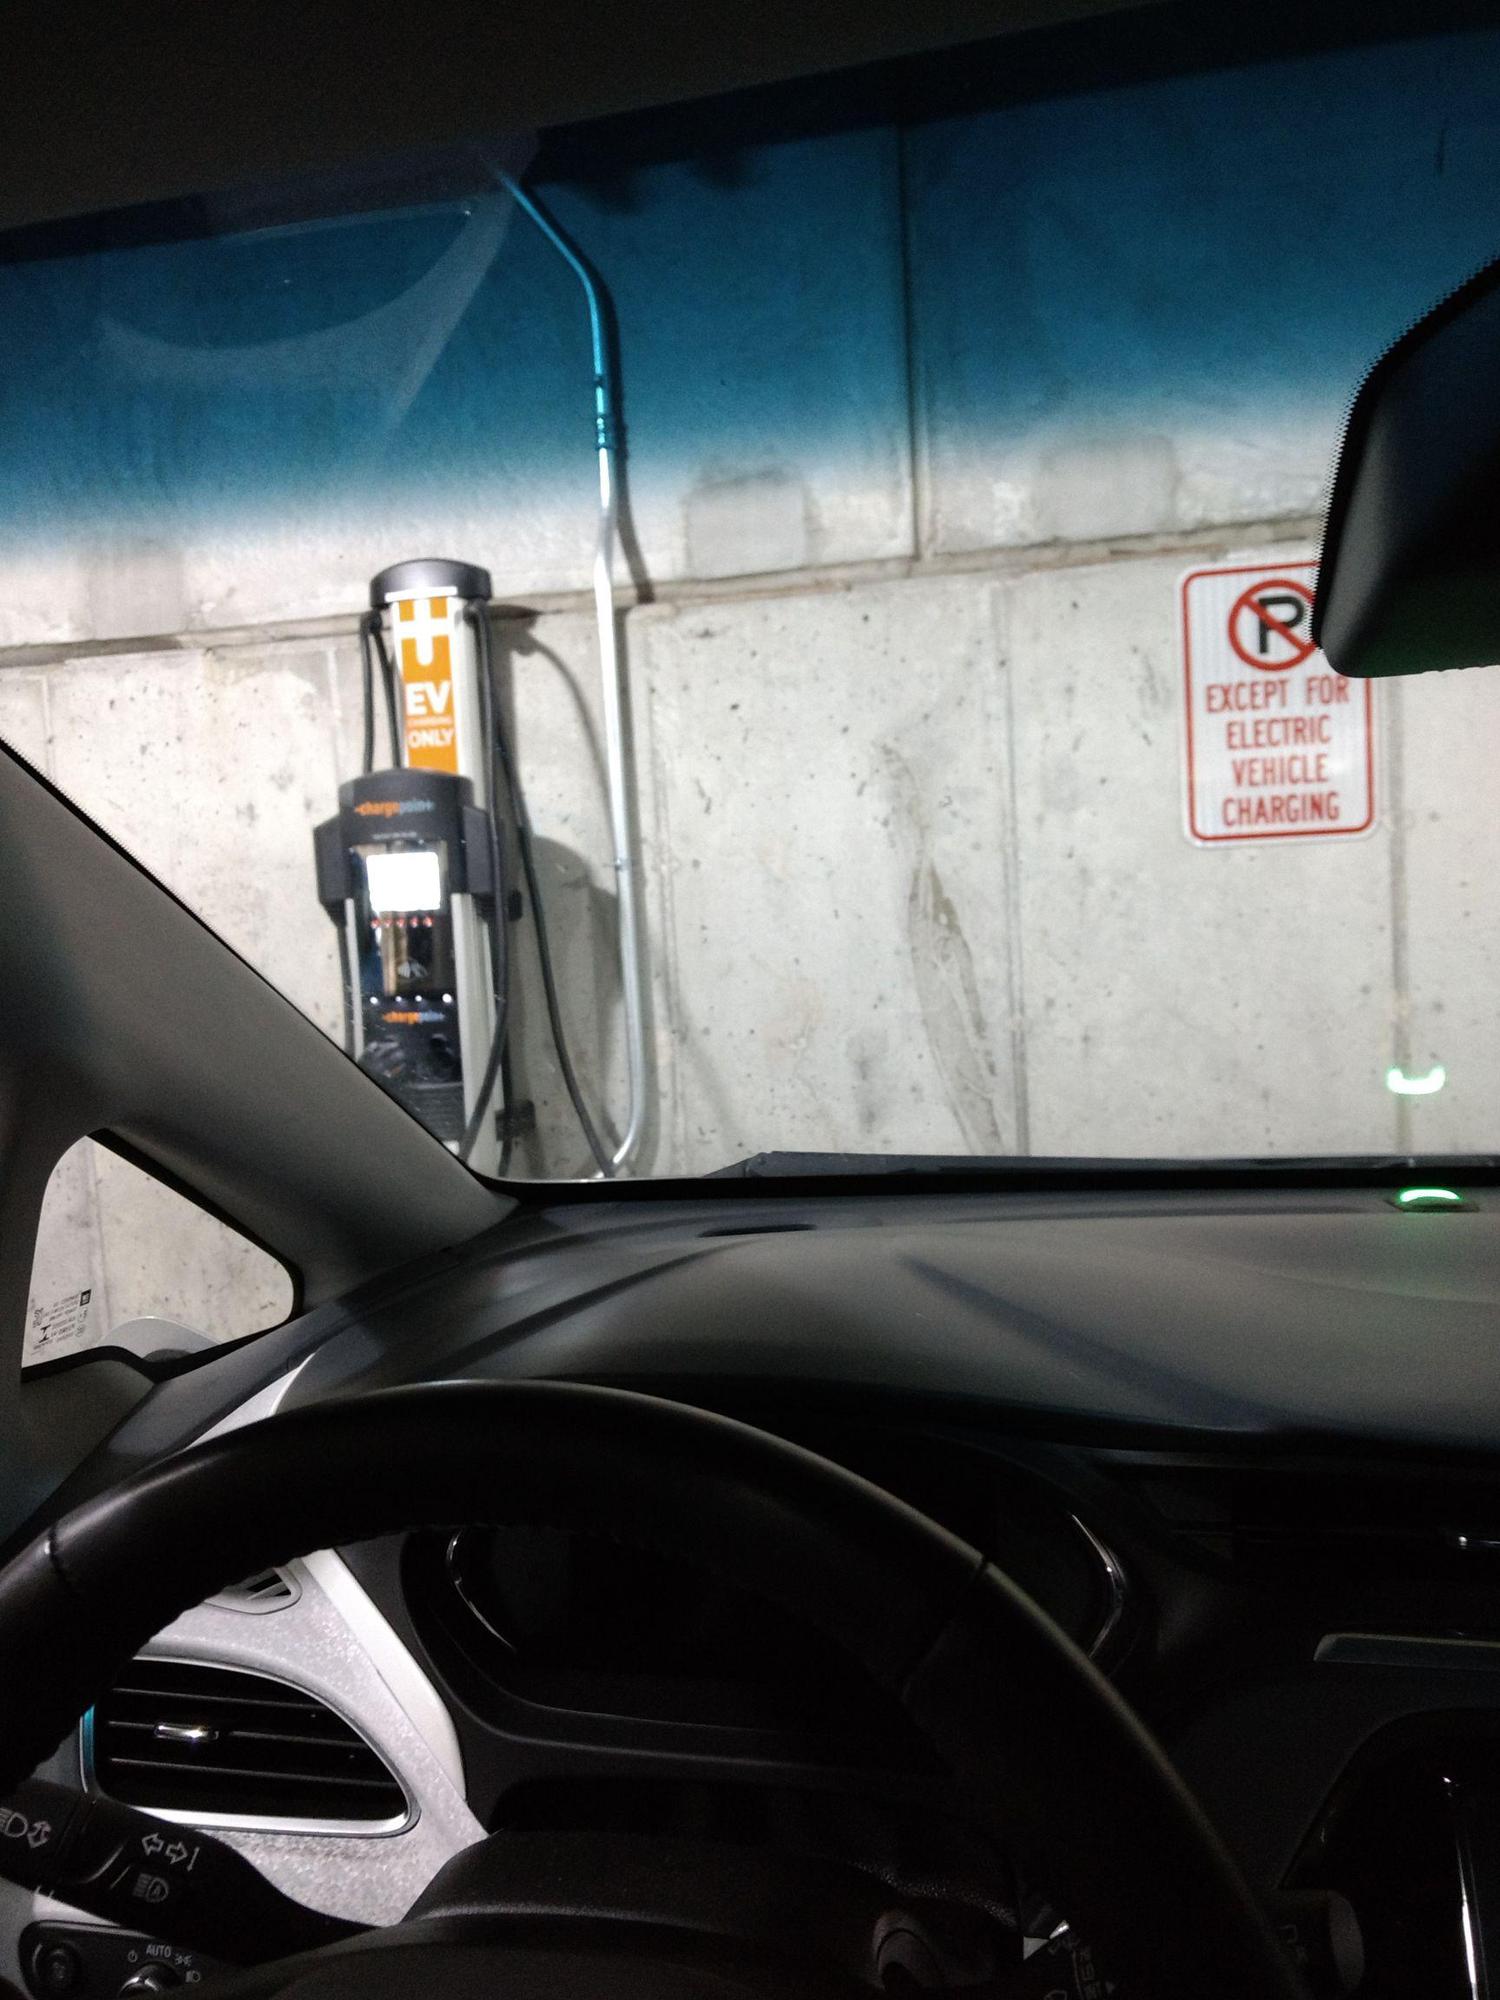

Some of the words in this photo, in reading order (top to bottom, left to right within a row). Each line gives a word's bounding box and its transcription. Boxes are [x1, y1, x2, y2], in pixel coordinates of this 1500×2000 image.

[405, 681, 451, 716] EV
[1206, 678, 1290, 713] EXCEPT
[1305, 674, 1350, 705] FOR
[407, 728, 455, 748] ONLY
[1226, 715, 1332, 750] ELECTRIC
[1231, 754, 1328, 787] VEHICLE
[1221, 792, 1340, 826] CHARGING
[146, 1944, 172, 1958] AUTO
